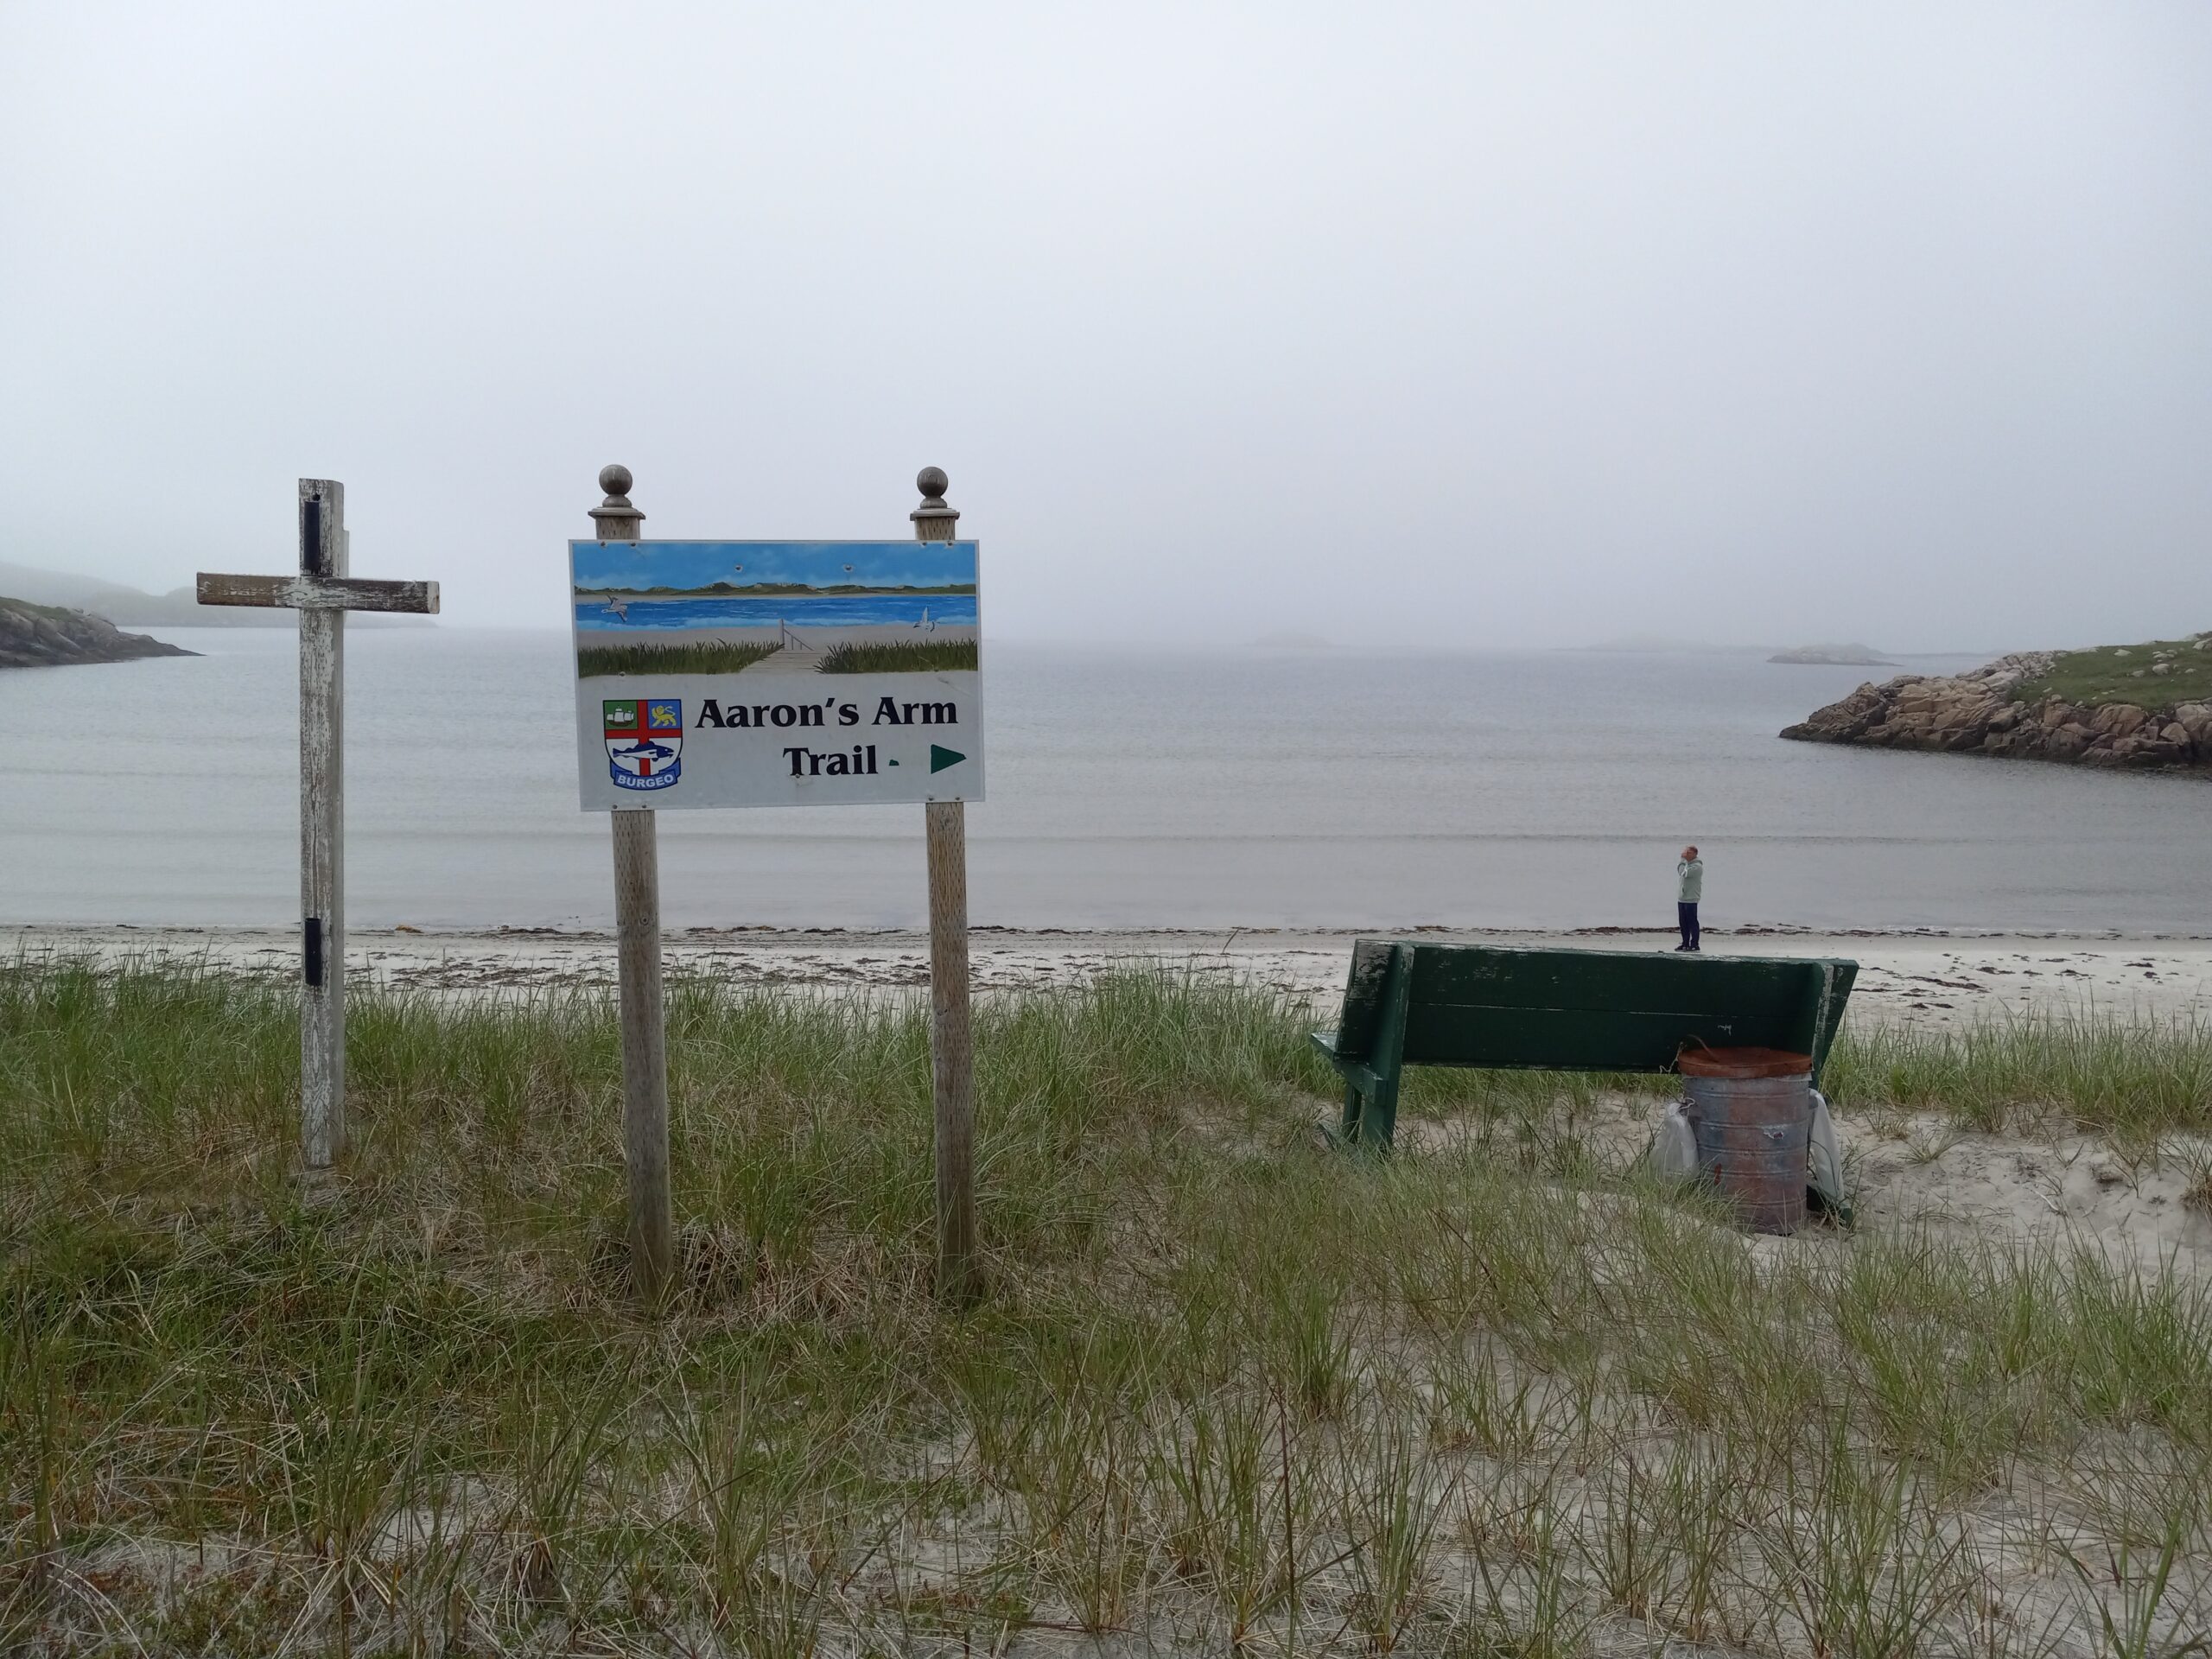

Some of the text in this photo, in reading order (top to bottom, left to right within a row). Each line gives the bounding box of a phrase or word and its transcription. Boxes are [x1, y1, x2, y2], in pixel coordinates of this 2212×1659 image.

[695, 696, 958, 728] Aaron's Arm
[782, 744, 879, 777] Trail
[617, 773, 675, 789] BURGEO
